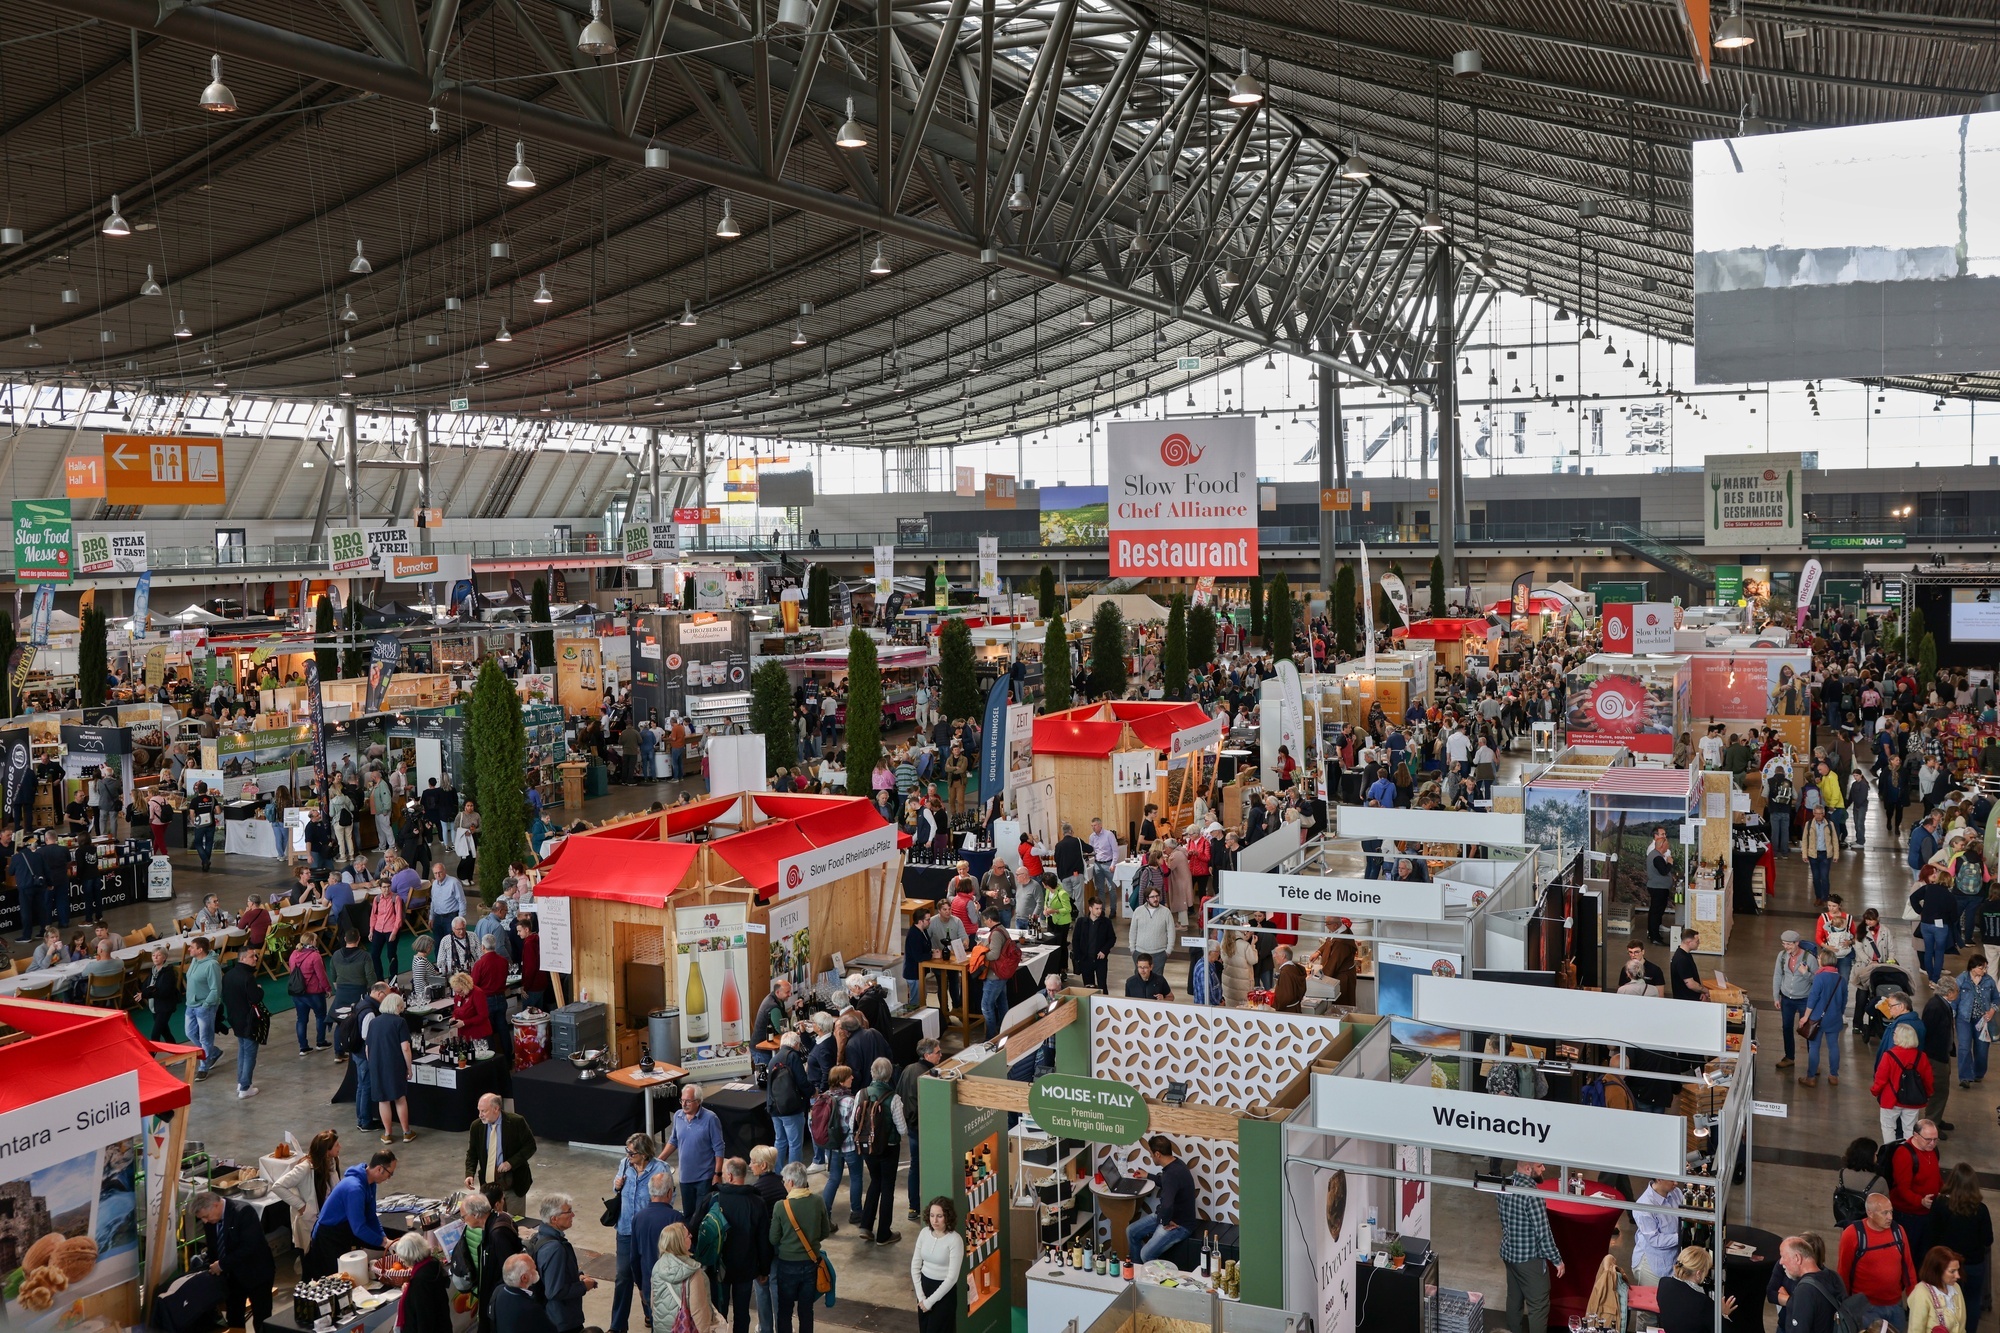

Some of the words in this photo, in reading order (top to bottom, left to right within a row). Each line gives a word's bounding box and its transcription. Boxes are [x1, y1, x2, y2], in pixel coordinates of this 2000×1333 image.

[68, 461, 87, 471] Halle
[87, 460, 97, 484] 1
[69, 475, 83, 485] Hall
[1124, 474, 1176, 496] Slow
[1723, 477, 1759, 490] MARKT
[1723, 491, 1744, 504] DES
[1749, 490, 1783, 504] GUTEN
[694, 510, 700, 520] 3
[1117, 502, 1162, 519] Chef
[1167, 501, 1248, 518] Alliance
[1723, 505, 1783, 519] GESCHMACKS
[20, 517, 33, 529] Die
[652, 525, 671, 534] MEAT
[15, 529, 42, 545] Slow
[43, 528, 70, 544] Food
[112, 536, 145, 548] STEAK
[331, 532, 363, 551] BBQ
[367, 529, 407, 544] FEUER
[626, 526, 648, 543] BBQ
[1830, 538, 1883, 546] GESUNDNAH
[81, 536, 108, 554] BBQ
[113, 548, 122, 556] IT
[123, 547, 146, 557] EASY!
[379, 543, 408, 553] FREI!
[627, 539, 649, 553] DAYS
[652, 540, 675, 549] GRILL
[24, 546, 57, 563] Messe
[83, 549, 109, 564] DAYS
[334, 546, 364, 562] DAYS
[1118, 538, 1248, 568] Restaurant
[396, 560, 434, 574] demeter
[556, 581, 565, 597] BIER
[1799, 565, 1817, 602] misereor
[1635, 628, 1653, 637] Slow
[1636, 637, 1671, 645] Deutschland
[539, 708, 562, 723] Ursprung
[1016, 712, 1029, 728] ZEIT
[991, 706, 1000, 748] WEINMOSEL
[989, 748, 997, 782] SÜDLICHE
[4, 765, 15, 814] Scones
[810, 863, 827, 877] Slow
[827, 857, 845, 871] Food
[845, 839, 891, 864] Rheinland-Pfalz
[101, 892, 126, 905] more
[1278, 885, 1310, 900] Tête
[1313, 887, 1332, 901] de
[1336, 888, 1381, 904] Moine
[780, 911, 799, 928] PETRI
[1041, 1085, 1091, 1103] MOLISE
[1097, 1091, 1135, 1108] ITALY
[76, 1100, 131, 1131] Sicilia
[1071, 1107, 1104, 1120] Premium
[1051, 1115, 1072, 1127] Extra
[1072, 1118, 1094, 1132] Virgin
[1095, 1121, 1113, 1133] Olive
[1114, 1123, 1125, 1135] Oil
[1432, 1105, 1551, 1144] Weinachy
